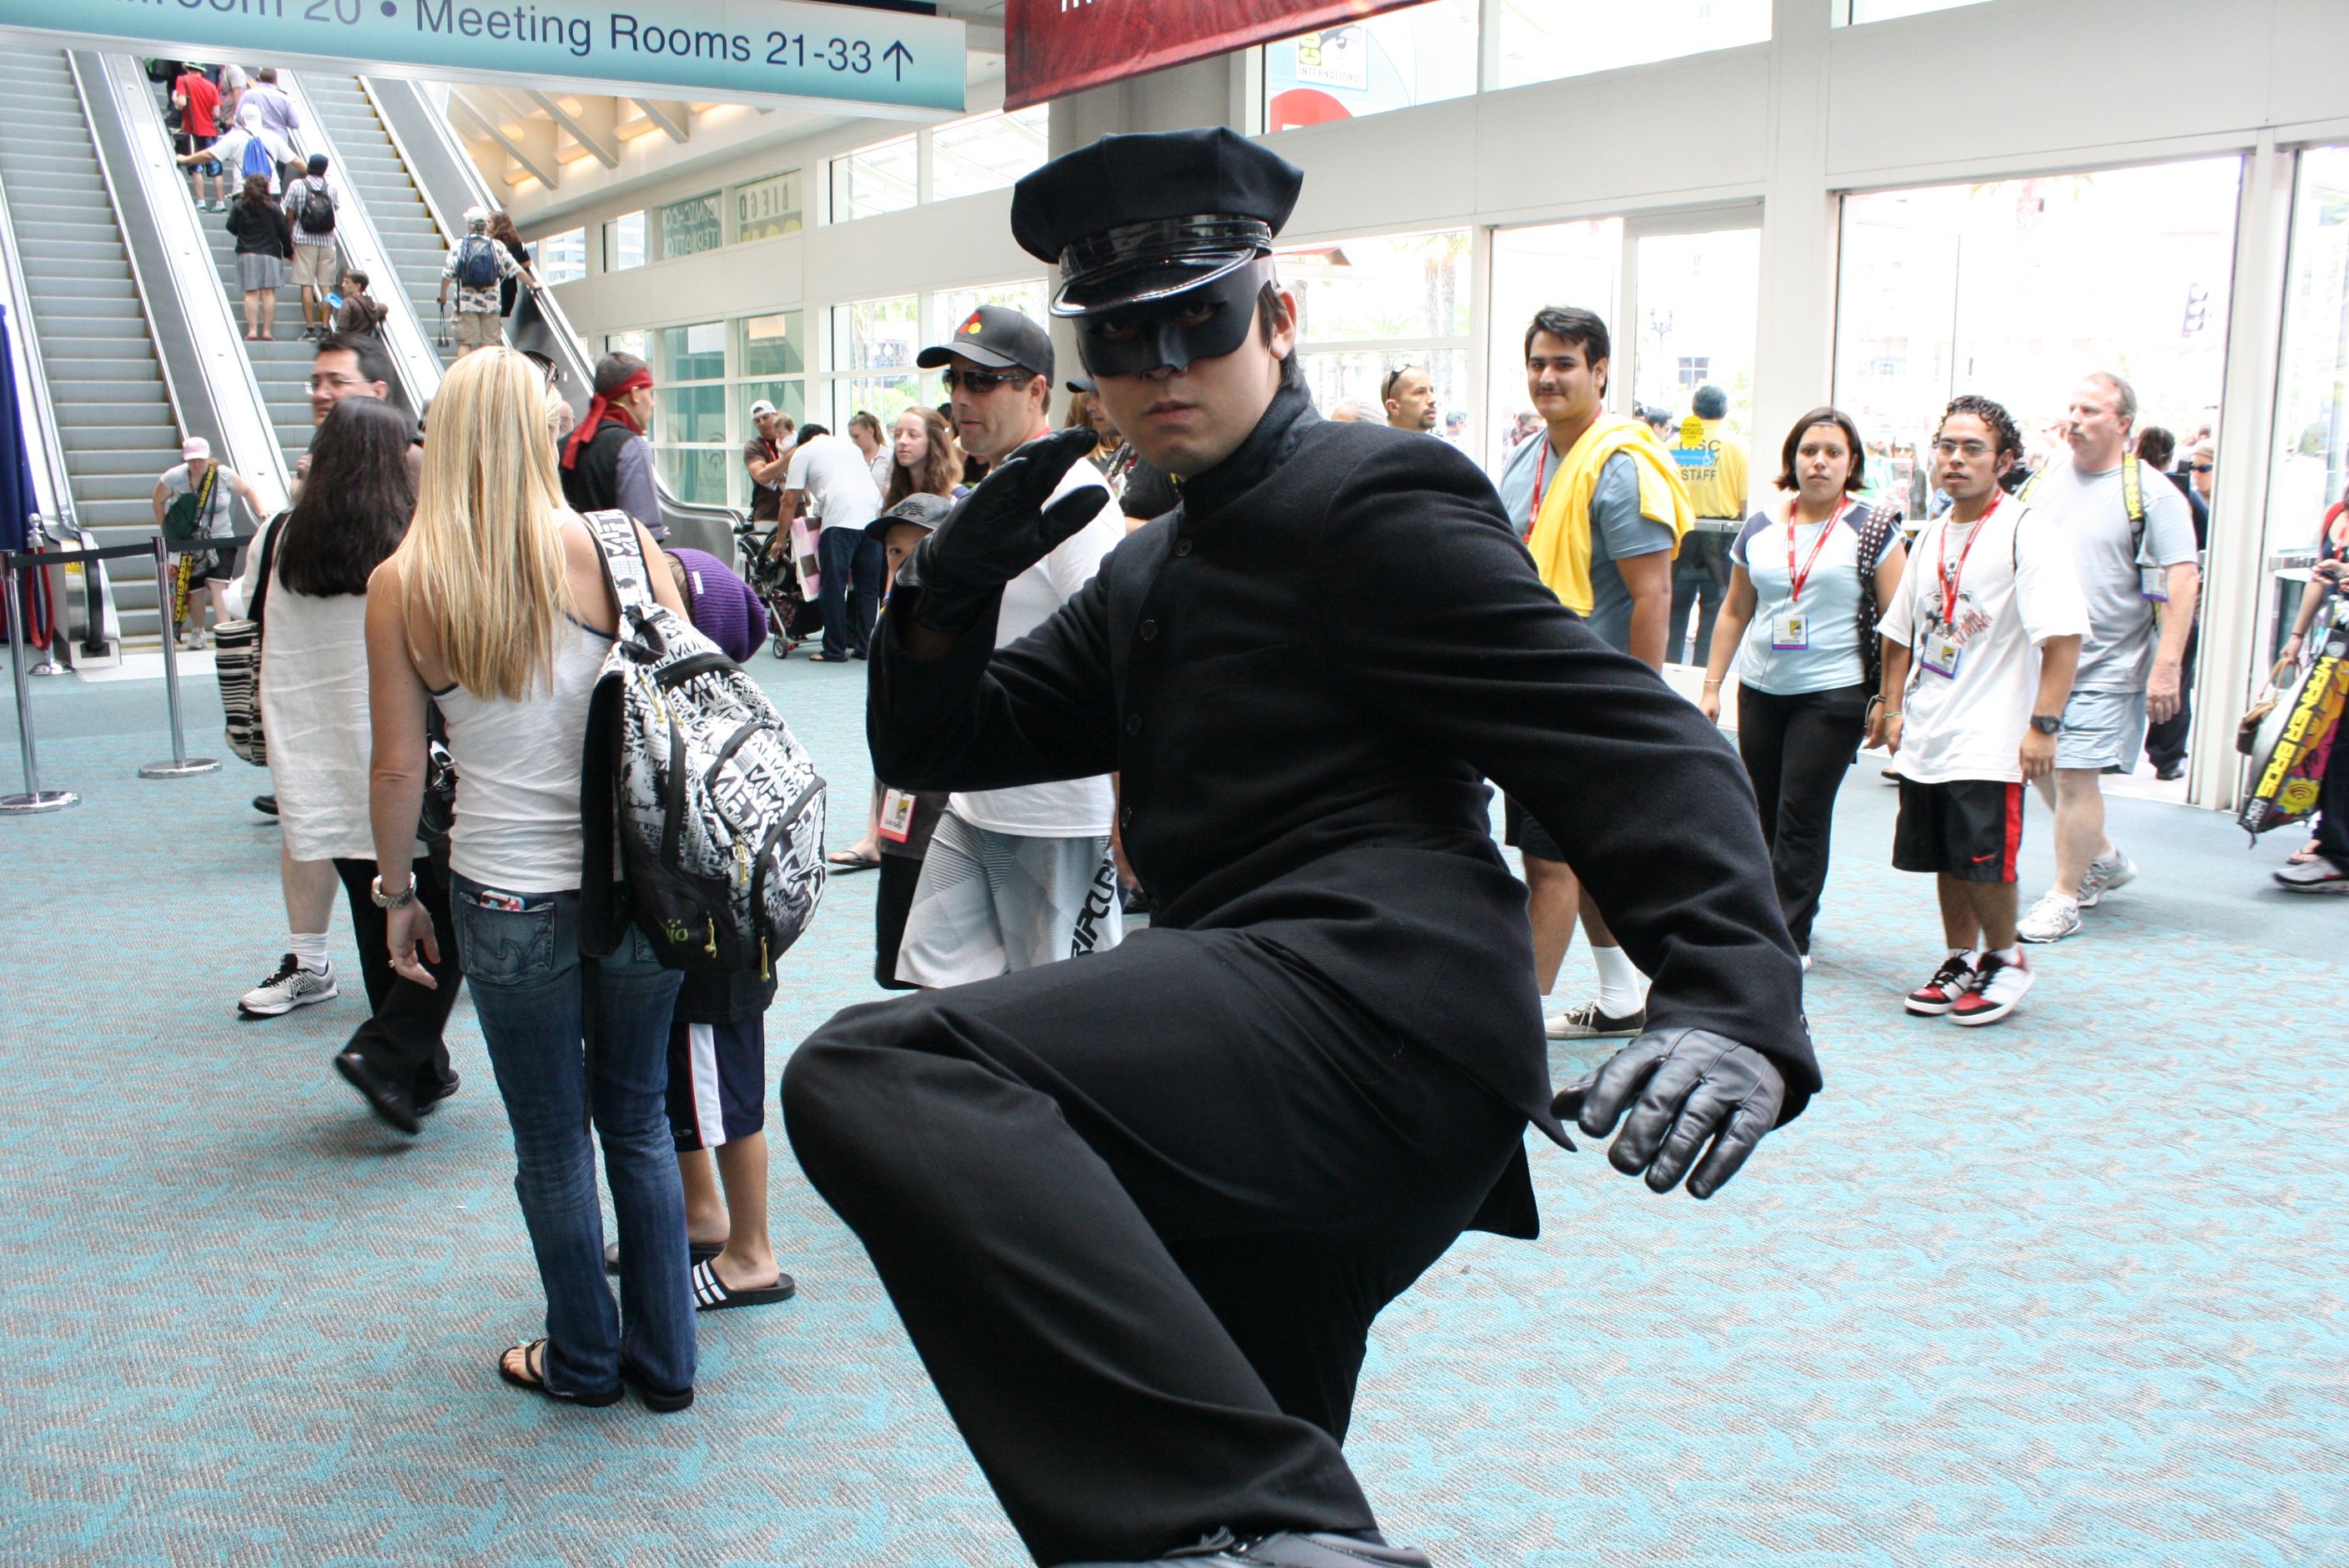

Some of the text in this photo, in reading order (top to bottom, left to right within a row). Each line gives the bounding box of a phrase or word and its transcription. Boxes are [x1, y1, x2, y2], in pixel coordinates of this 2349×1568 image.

[417, 0, 591, 57] Meeting
[611, 13, 751, 62] Rooms
[767, 31, 872, 73] 21-33
[1299, 66, 1362, 83] INTERNATIONAL
[1681, 469, 1717, 481] STAFF
[176, 555, 189, 596] WARNER
[2283, 656, 2339, 742] WARNER
